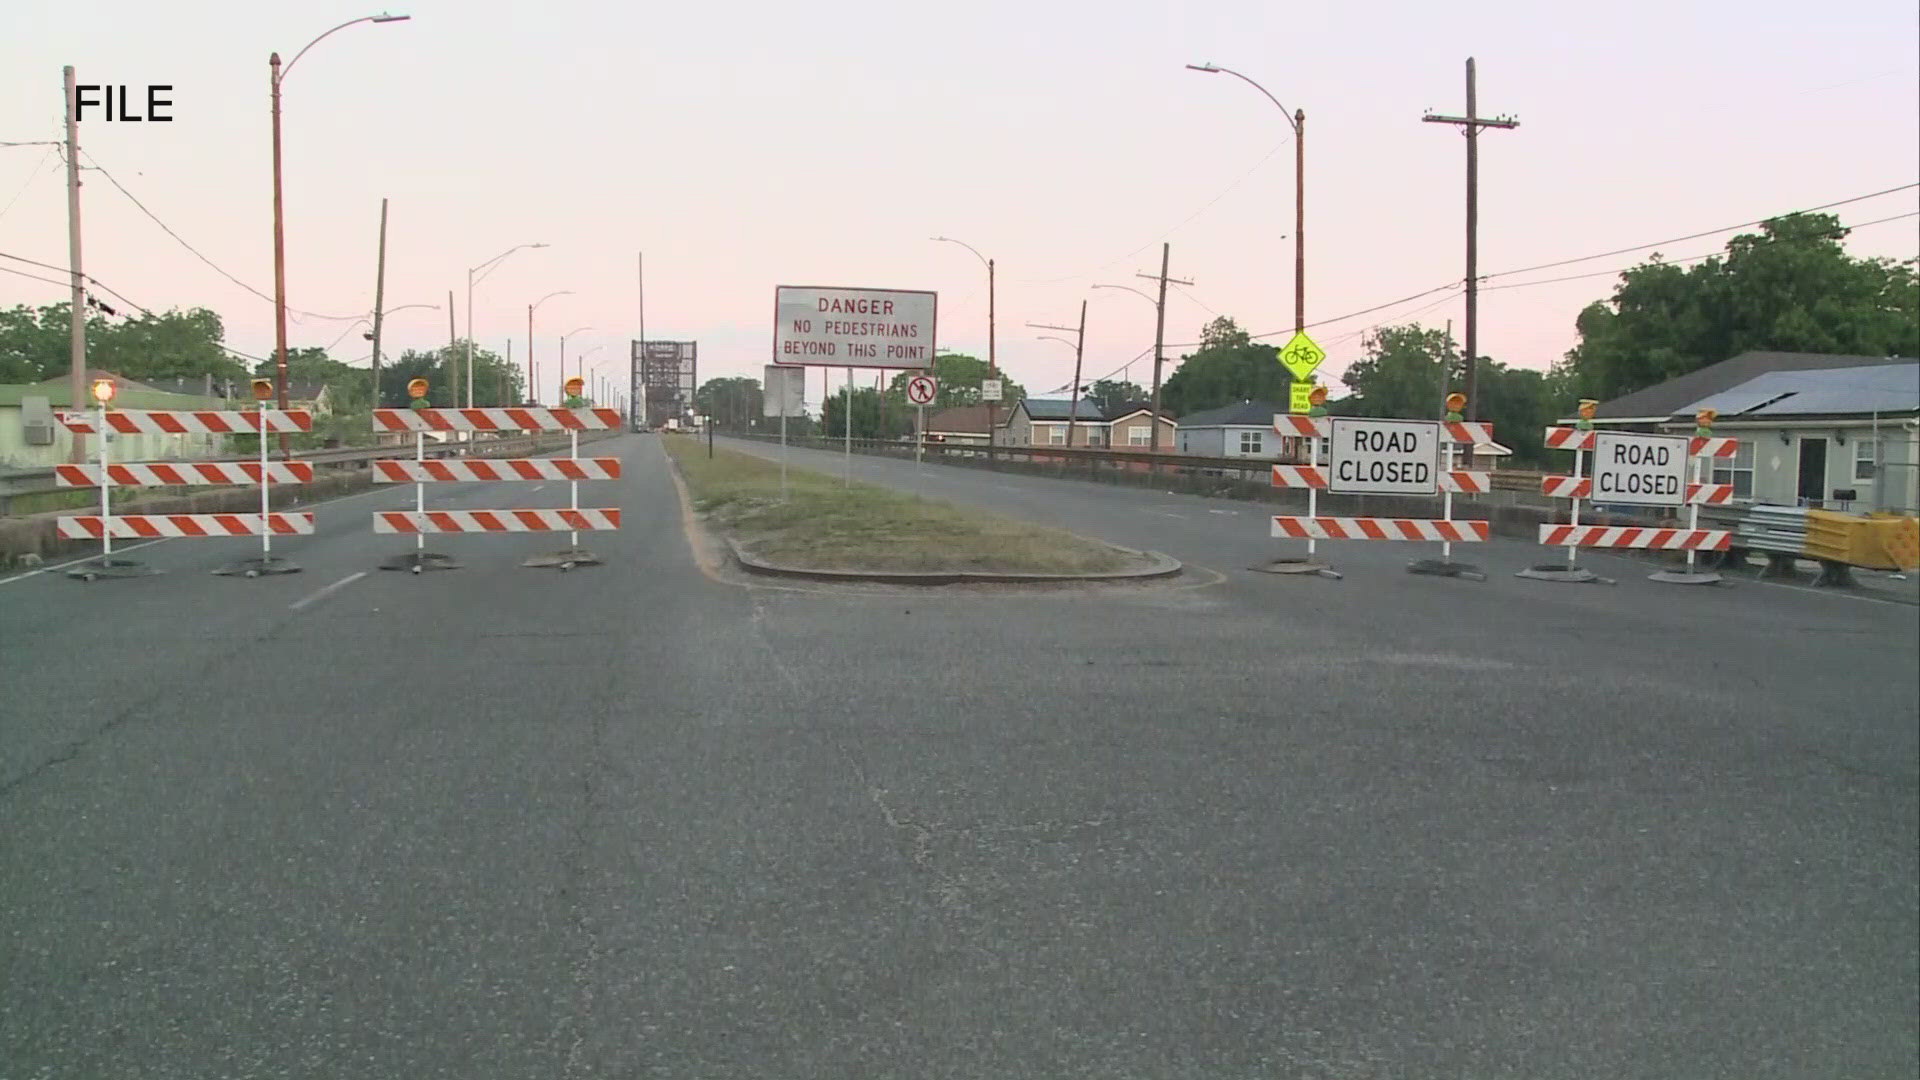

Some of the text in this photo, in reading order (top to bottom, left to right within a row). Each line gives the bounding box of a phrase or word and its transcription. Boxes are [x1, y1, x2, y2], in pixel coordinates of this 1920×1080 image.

[818, 297, 894, 315] DANGER
[793, 319, 918, 338] NO PEDESTRIANS
[784, 340, 926, 359] BEYOND THIS POINT
[1354, 430, 1417, 453] ROAD
[1614, 444, 1669, 466] ROAD
[1340, 460, 1428, 483] CLOSED
[1600, 472, 1678, 495] CLOSED
